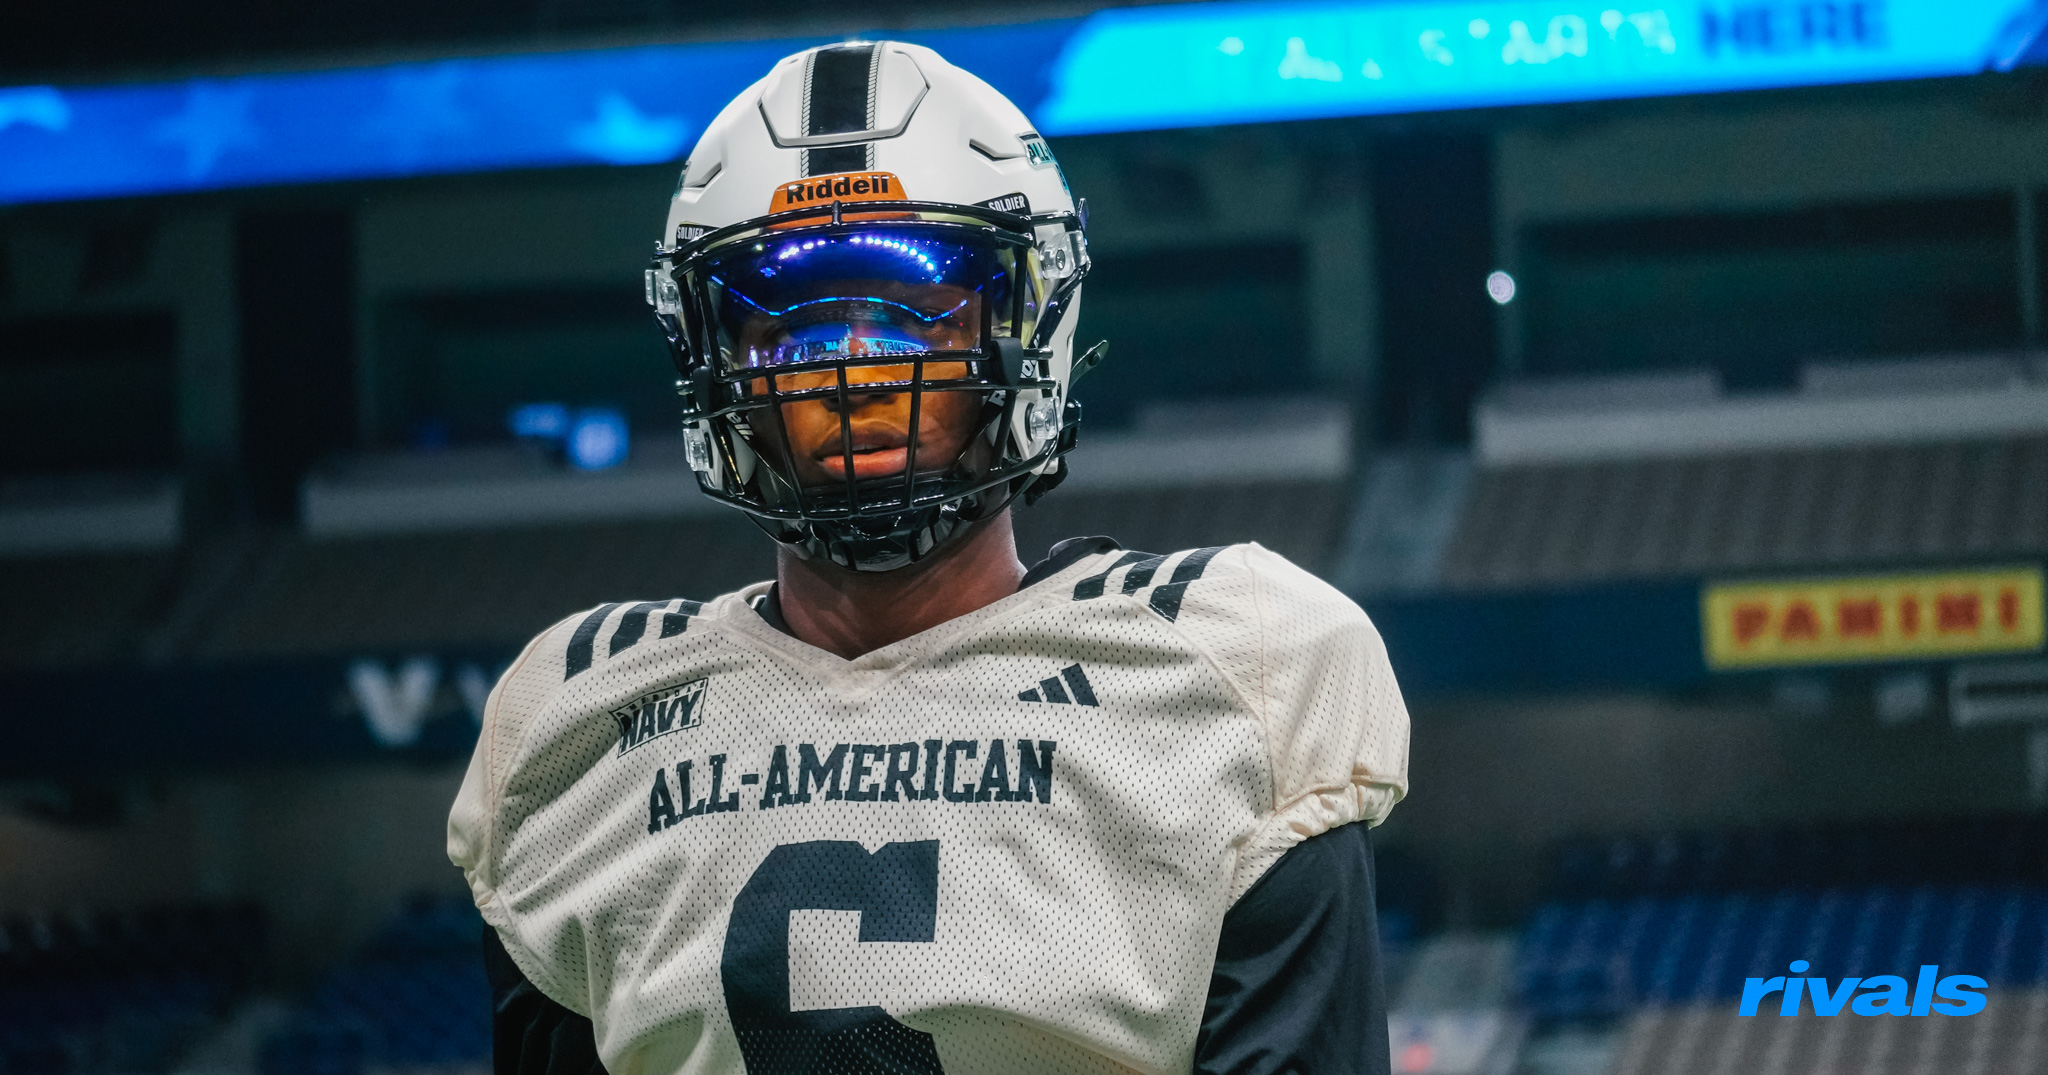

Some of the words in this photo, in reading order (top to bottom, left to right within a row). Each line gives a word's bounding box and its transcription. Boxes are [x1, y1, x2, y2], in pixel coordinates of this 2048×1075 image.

[786, 175, 888, 204] Riddell
[988, 195, 1026, 212] SOLDIER
[677, 226, 704, 240] SOLDIER
[1731, 586, 2021, 646] PANINI
[648, 738, 1057, 834] ALL-AMERICAN
[721, 839, 945, 1075] 6
